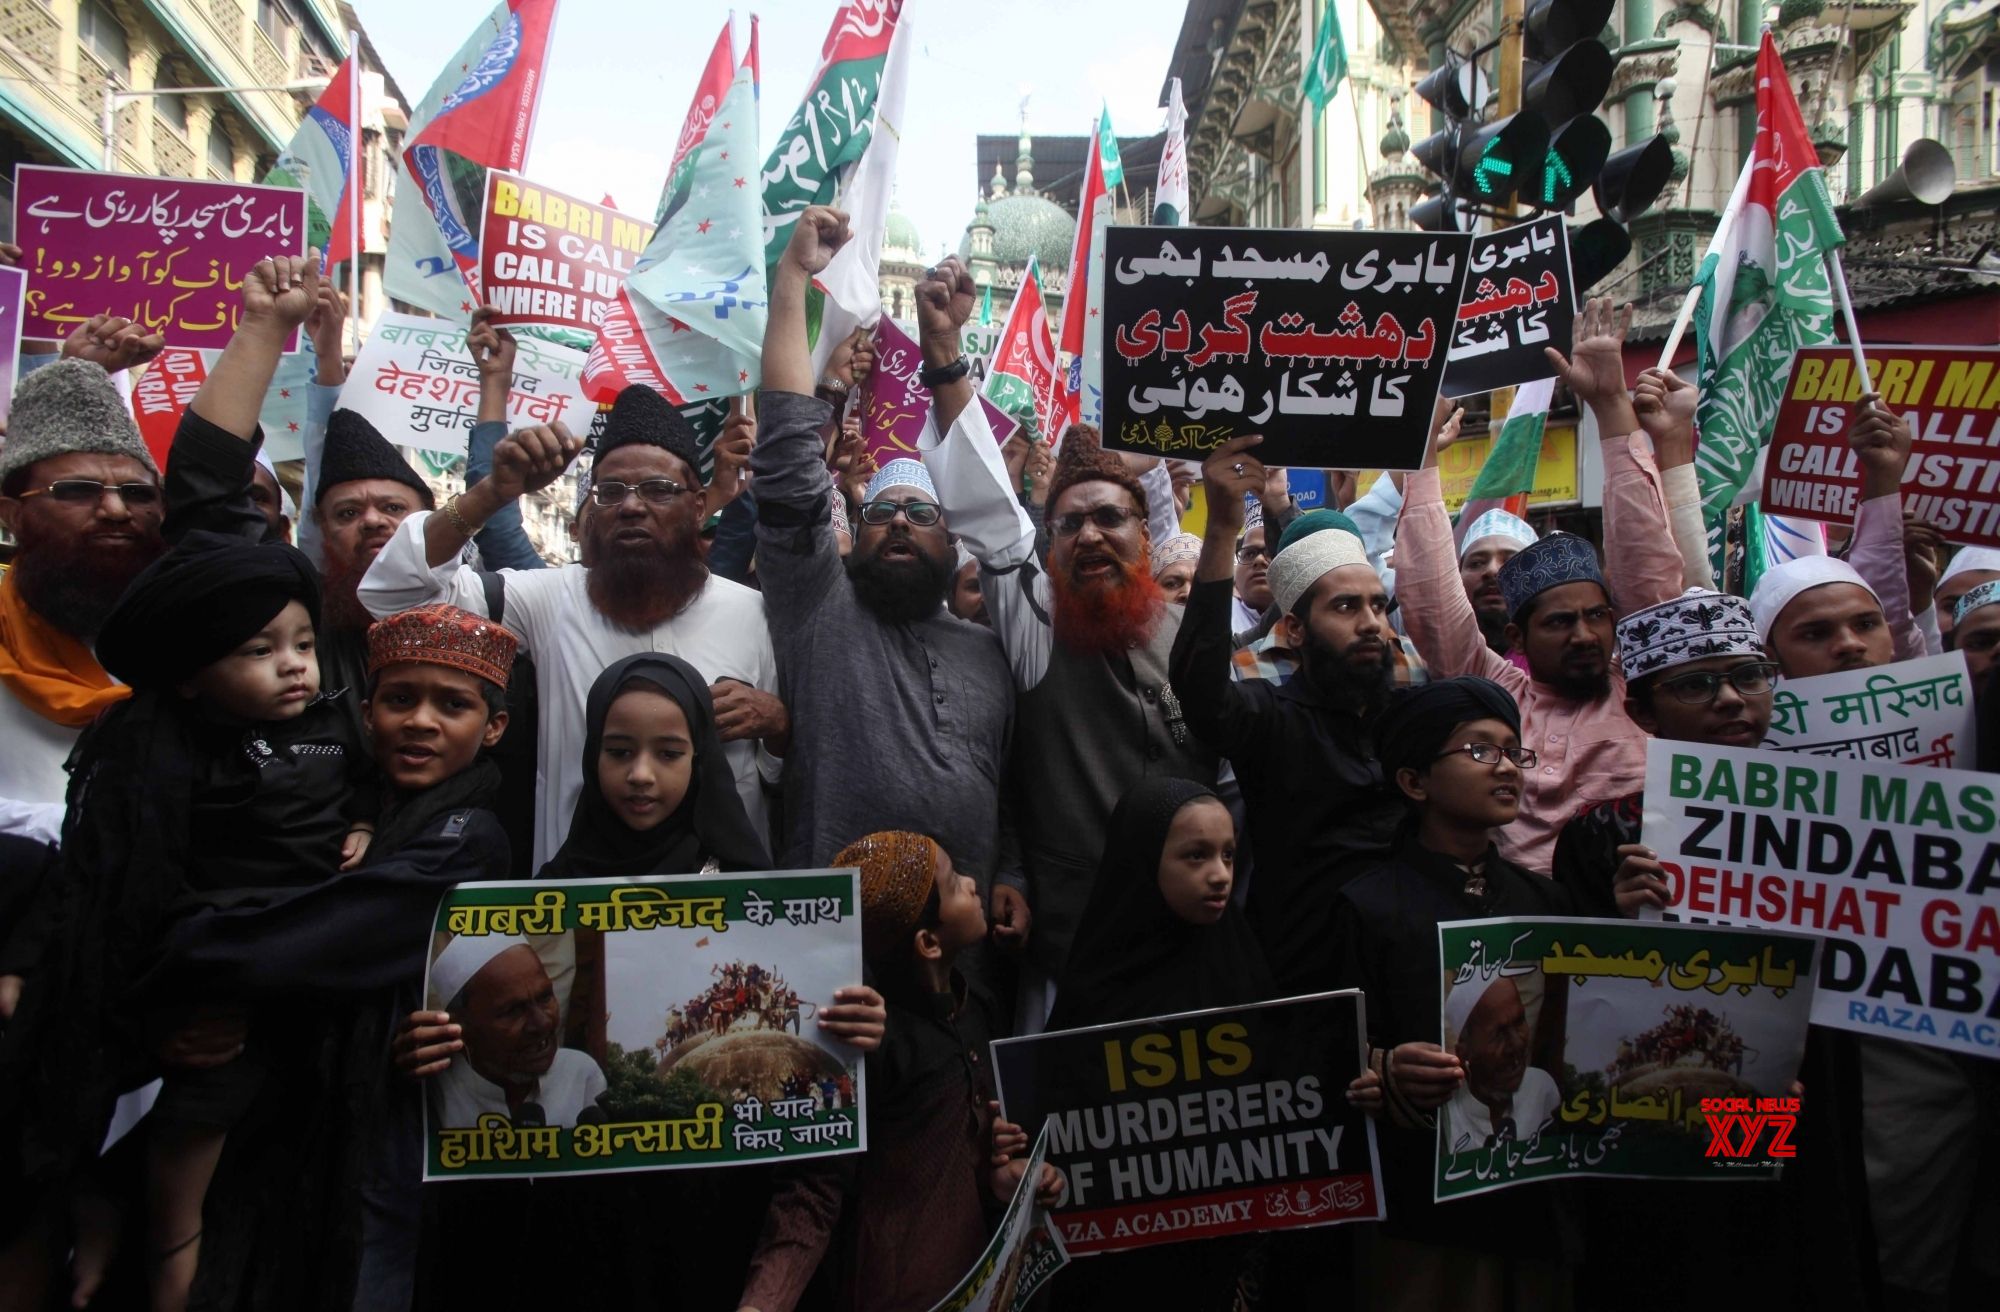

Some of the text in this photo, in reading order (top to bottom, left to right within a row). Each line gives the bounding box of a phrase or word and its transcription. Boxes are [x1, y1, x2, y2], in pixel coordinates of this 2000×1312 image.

[494, 180, 604, 240] BABRI
[507, 220, 547, 250] IS
[1471, 226, 1557, 273] بابری
[494, 252, 574, 288] CALL
[1114, 240, 1456, 294] بابری مسجد بھی
[488, 285, 607, 326] WHERE IS
[1517, 310, 1551, 345] کا
[380, 323, 468, 354] बाबरी
[1248, 370, 1359, 424] شکار
[1370, 373, 1412, 417] کا
[1791, 358, 1935, 405] BABRI
[1804, 406, 1846, 435] IS
[1780, 443, 1859, 479] CALL
[1771, 478, 1859, 517] WHERE
[1823, 673, 1963, 726] मस्जिद
[1669, 754, 1997, 834] BABRI MAS
[1680, 806, 2000, 896] ZINDABA
[447, 887, 842, 937] बाबरी मस्जिद के साथ
[1659, 861, 1900, 939] DEHSHAT
[1541, 941, 1667, 986] مسجد
[1669, 946, 1796, 1000] بابری
[1848, 1000, 2000, 1048] RAZA AC
[1104, 1023, 1252, 1092] ISIS
[733, 1096, 817, 1121] भी याद
[1047, 1075, 1324, 1155] MURDERERS
[439, 1102, 727, 1169] हाशिम अन्सारी
[733, 1113, 856, 1152] किए जाएंगे
[1111, 1126, 1345, 1201] HUMANITY
[1111, 1201, 1254, 1239] ACADEMY
